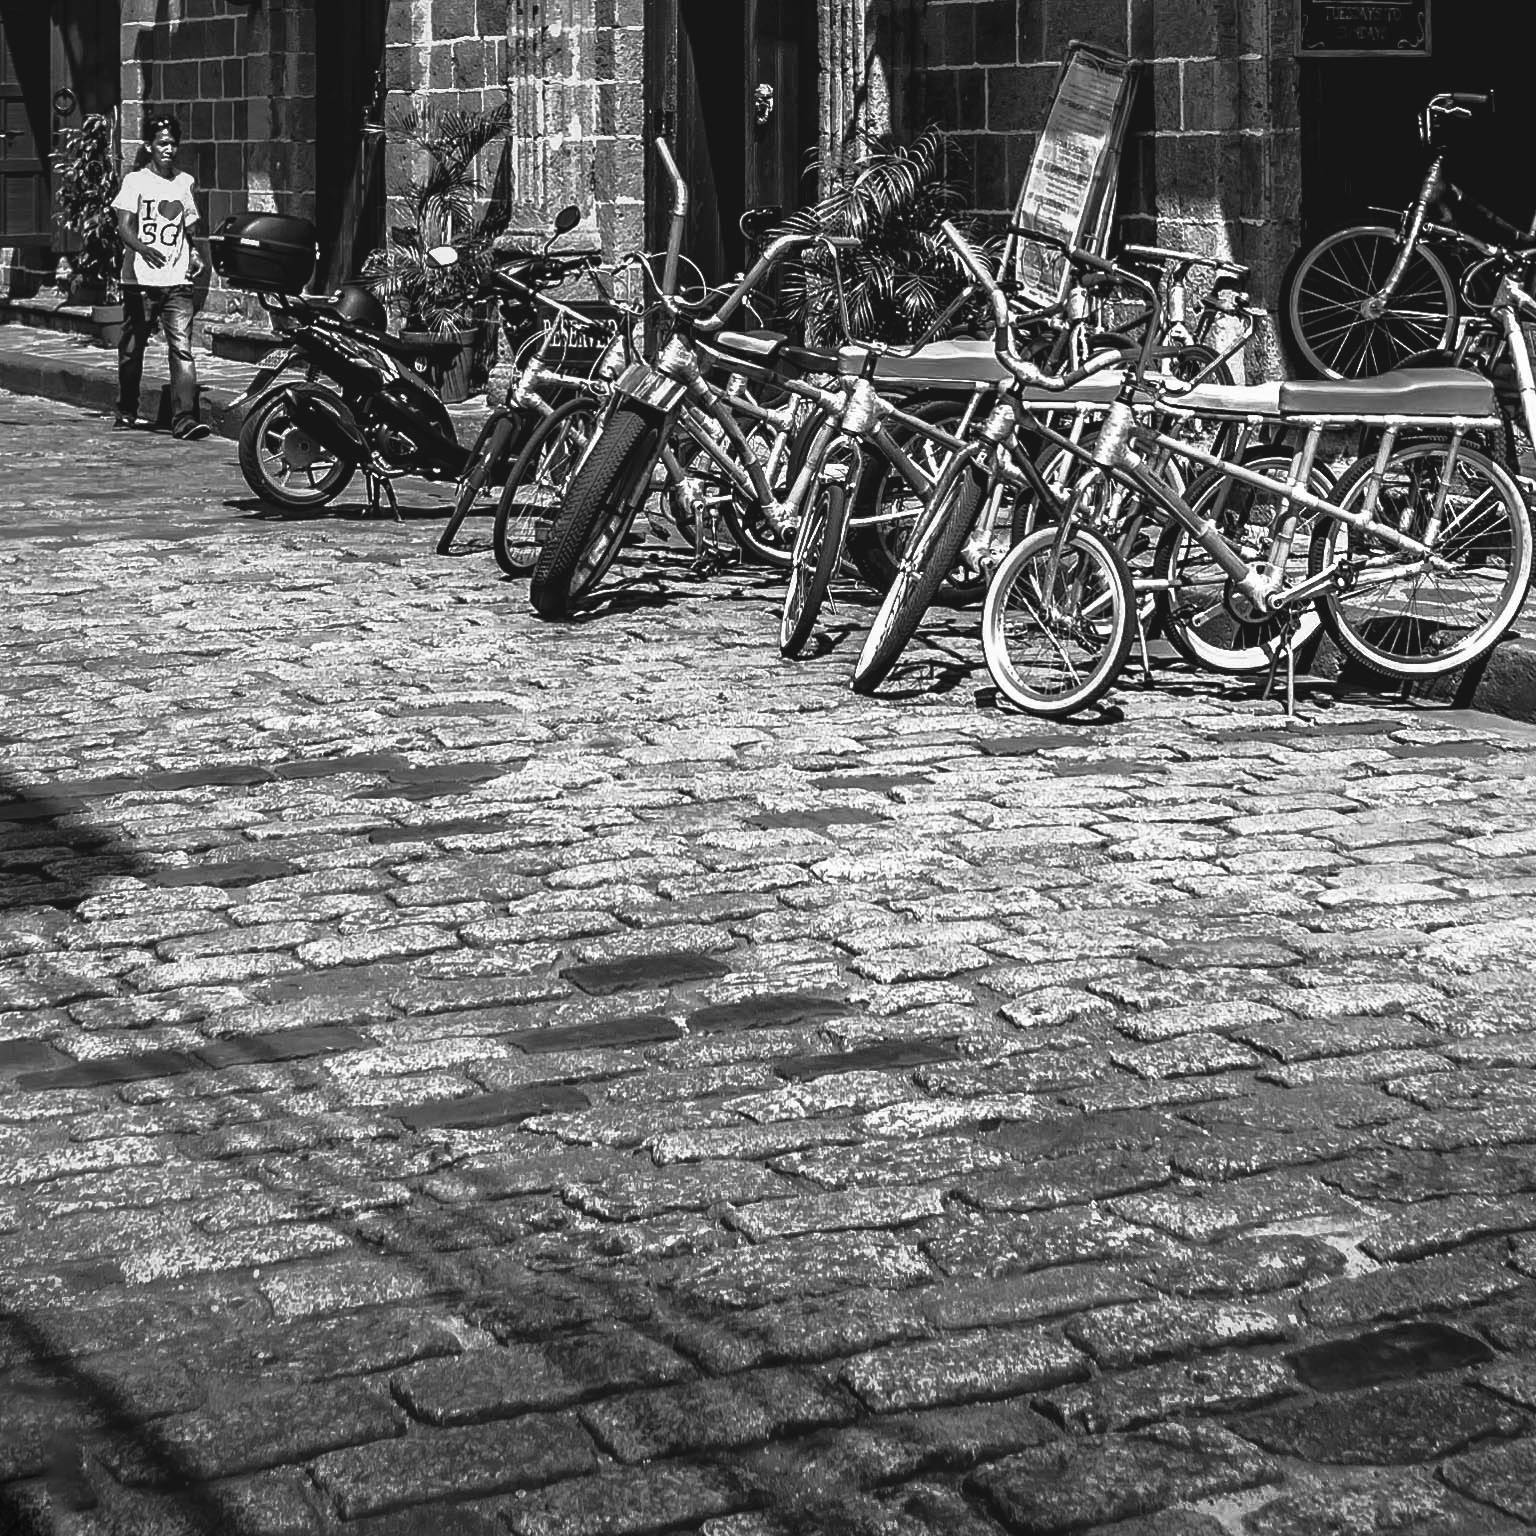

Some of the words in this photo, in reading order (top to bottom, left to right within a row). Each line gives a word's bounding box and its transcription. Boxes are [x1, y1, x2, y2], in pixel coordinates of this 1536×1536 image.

[142, 199, 156, 221] I
[142, 223, 180, 247] SG
[544, 319, 618, 348] REED
